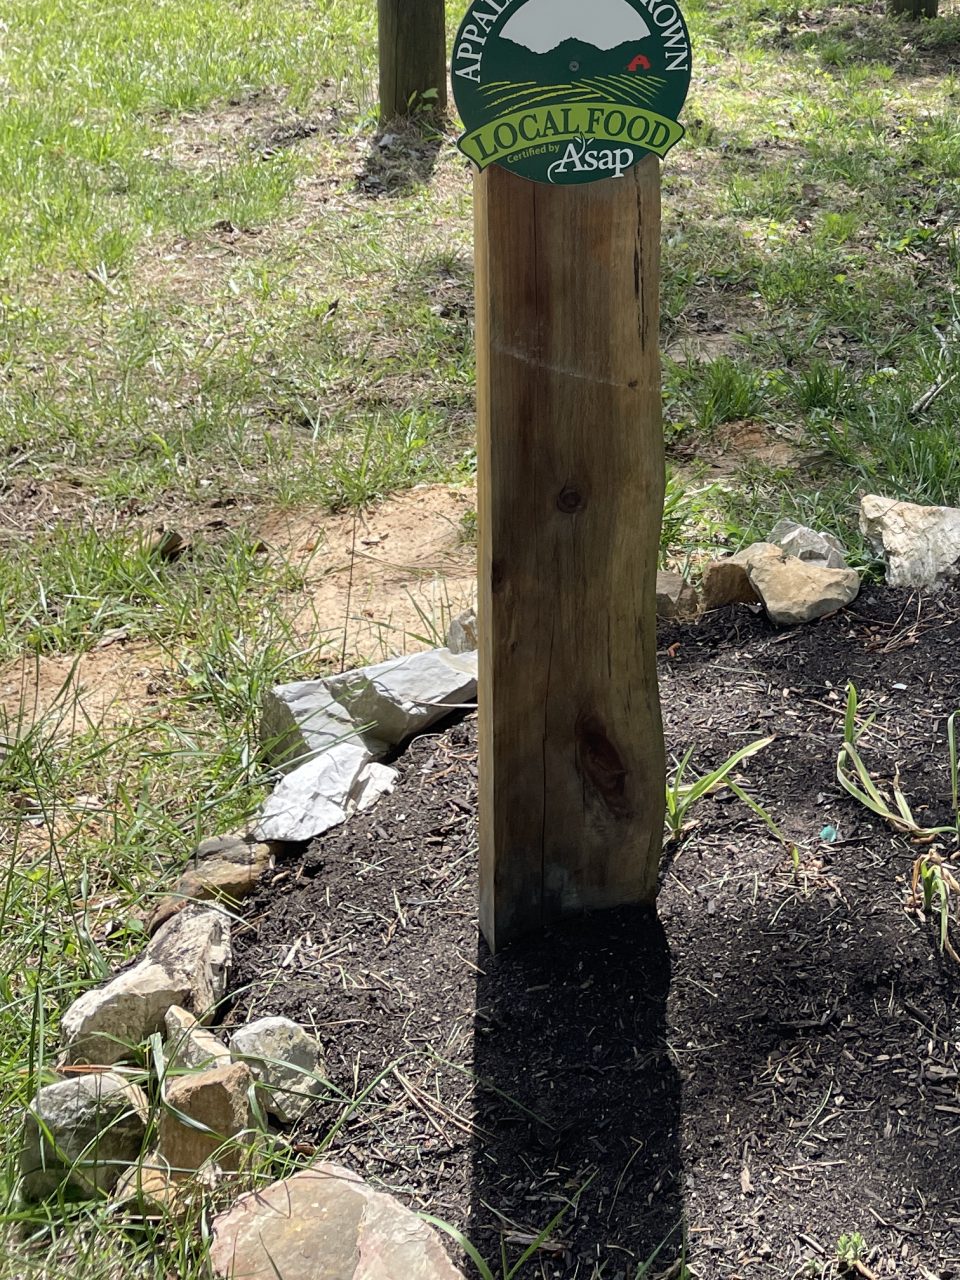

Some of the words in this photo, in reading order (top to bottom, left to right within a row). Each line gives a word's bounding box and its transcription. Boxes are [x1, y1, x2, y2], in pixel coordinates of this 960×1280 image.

[471, 108, 580, 161] LOCAL
[584, 107, 671, 148] FOOD
[507, 144, 547, 164] Certified
[547, 143, 560, 154] by
